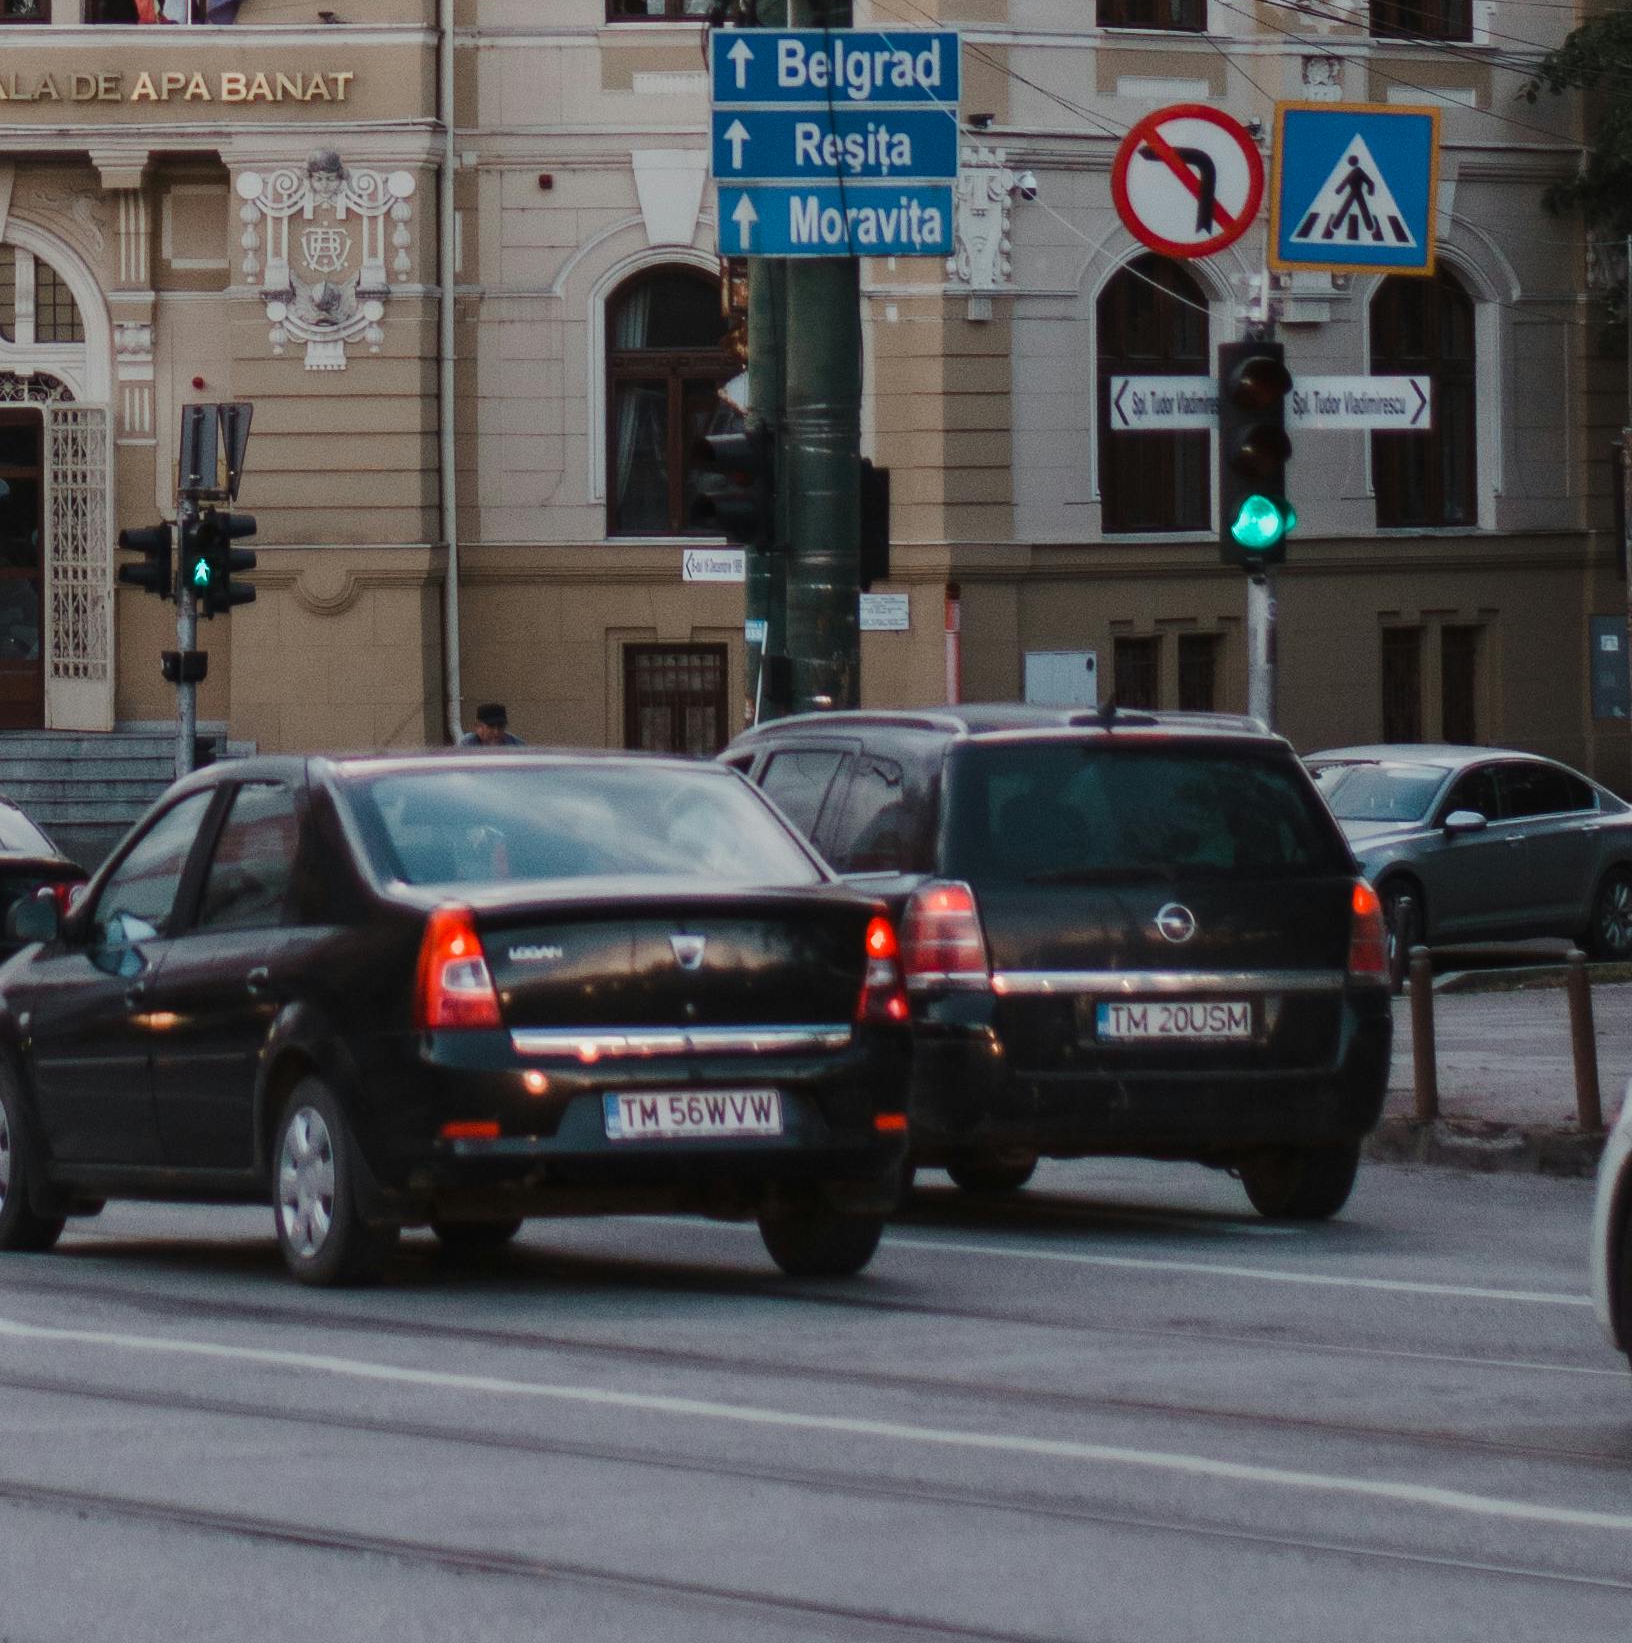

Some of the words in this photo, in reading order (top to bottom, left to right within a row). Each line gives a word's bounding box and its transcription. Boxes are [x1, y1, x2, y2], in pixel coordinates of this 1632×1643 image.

[777, 39, 941, 100] Belgrad
[70, 72, 122, 102] DE
[130, 71, 212, 101] APA
[220, 71, 354, 101] BANAT
[1313, 390, 1341, 415] Tudor
[1111, 1005, 1148, 1033] TM
[1158, 1005, 1249, 1033] 20USM
[621, 1097, 659, 1128] TM
[669, 1095, 772, 1126] 56WVW
